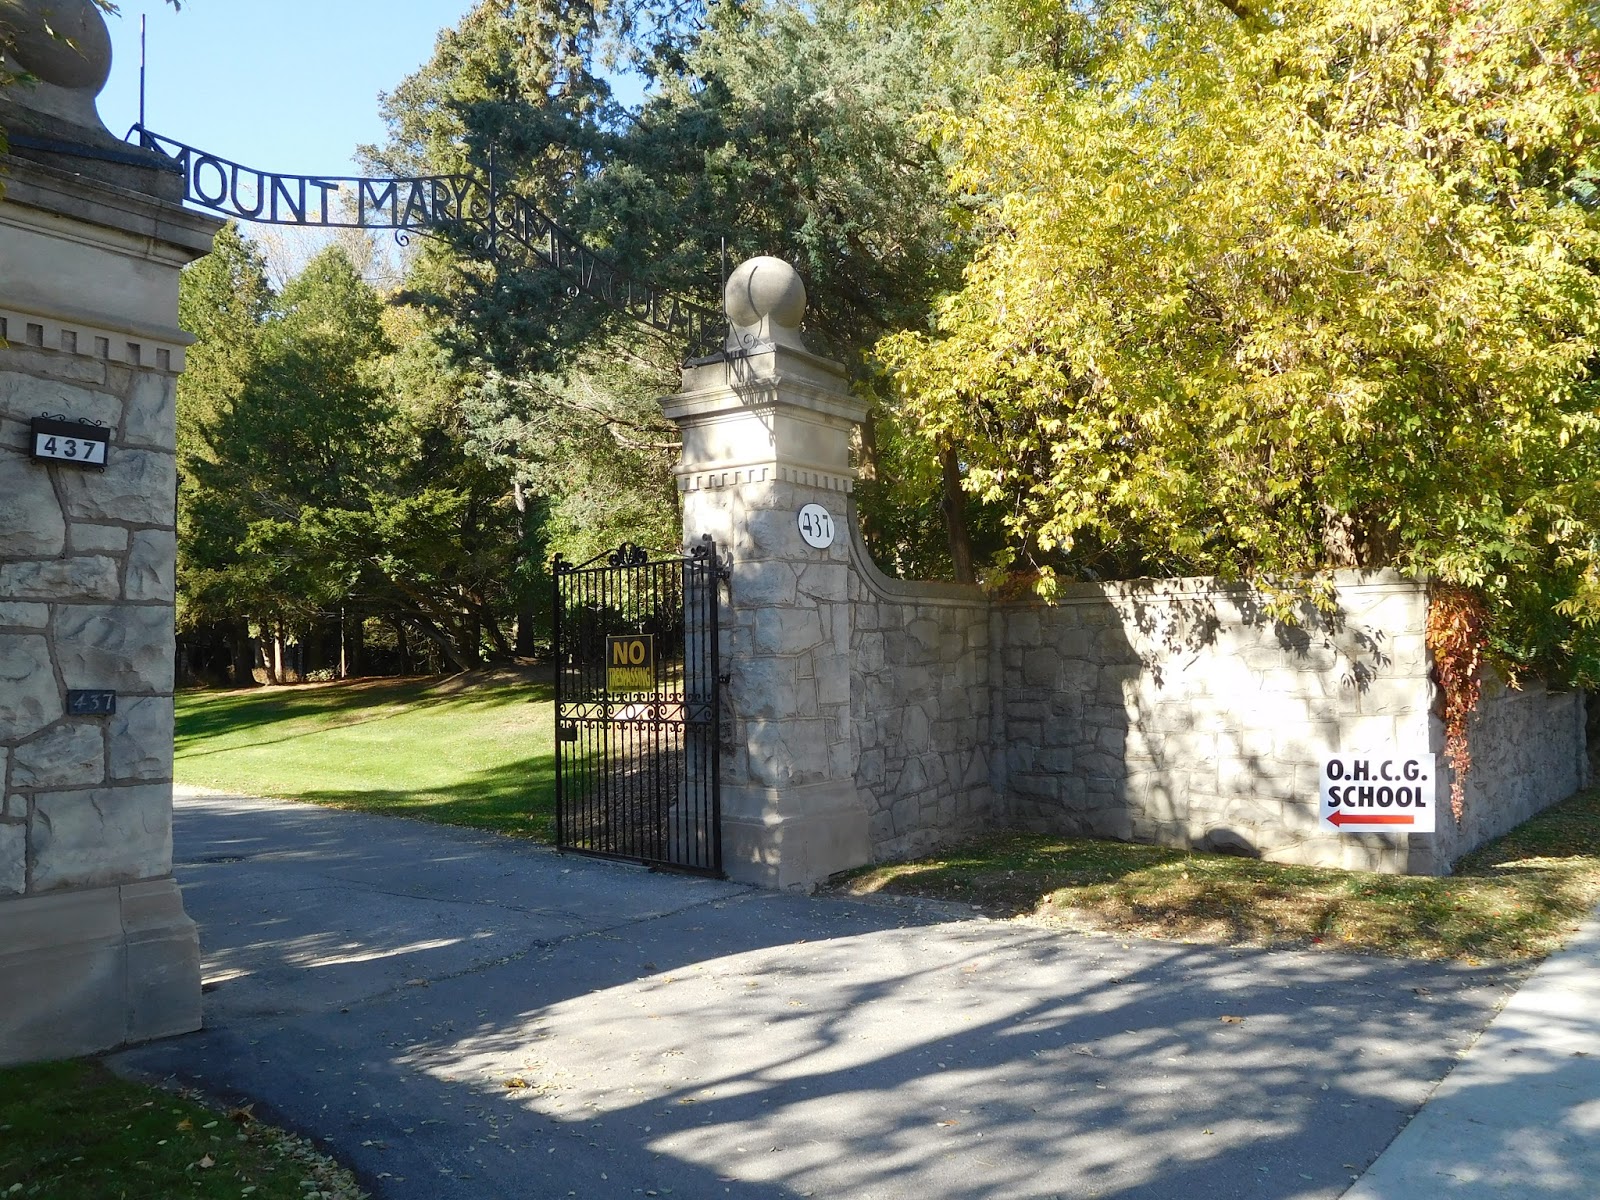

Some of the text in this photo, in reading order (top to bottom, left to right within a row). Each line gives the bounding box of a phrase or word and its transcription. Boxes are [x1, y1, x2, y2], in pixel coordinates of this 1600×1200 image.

[146, 130, 338, 225] MOUNT
[358, 175, 472, 227] MARY
[44, 436, 97, 460] 437
[802, 512, 830, 538] 437
[613, 641, 645, 665] NO
[608, 667, 650, 687] TRESPASSING
[74, 693, 114, 711] 437
[1326, 759, 1428, 781] O.H.C.G.
[1327, 786, 1426, 808] SCHOOL
